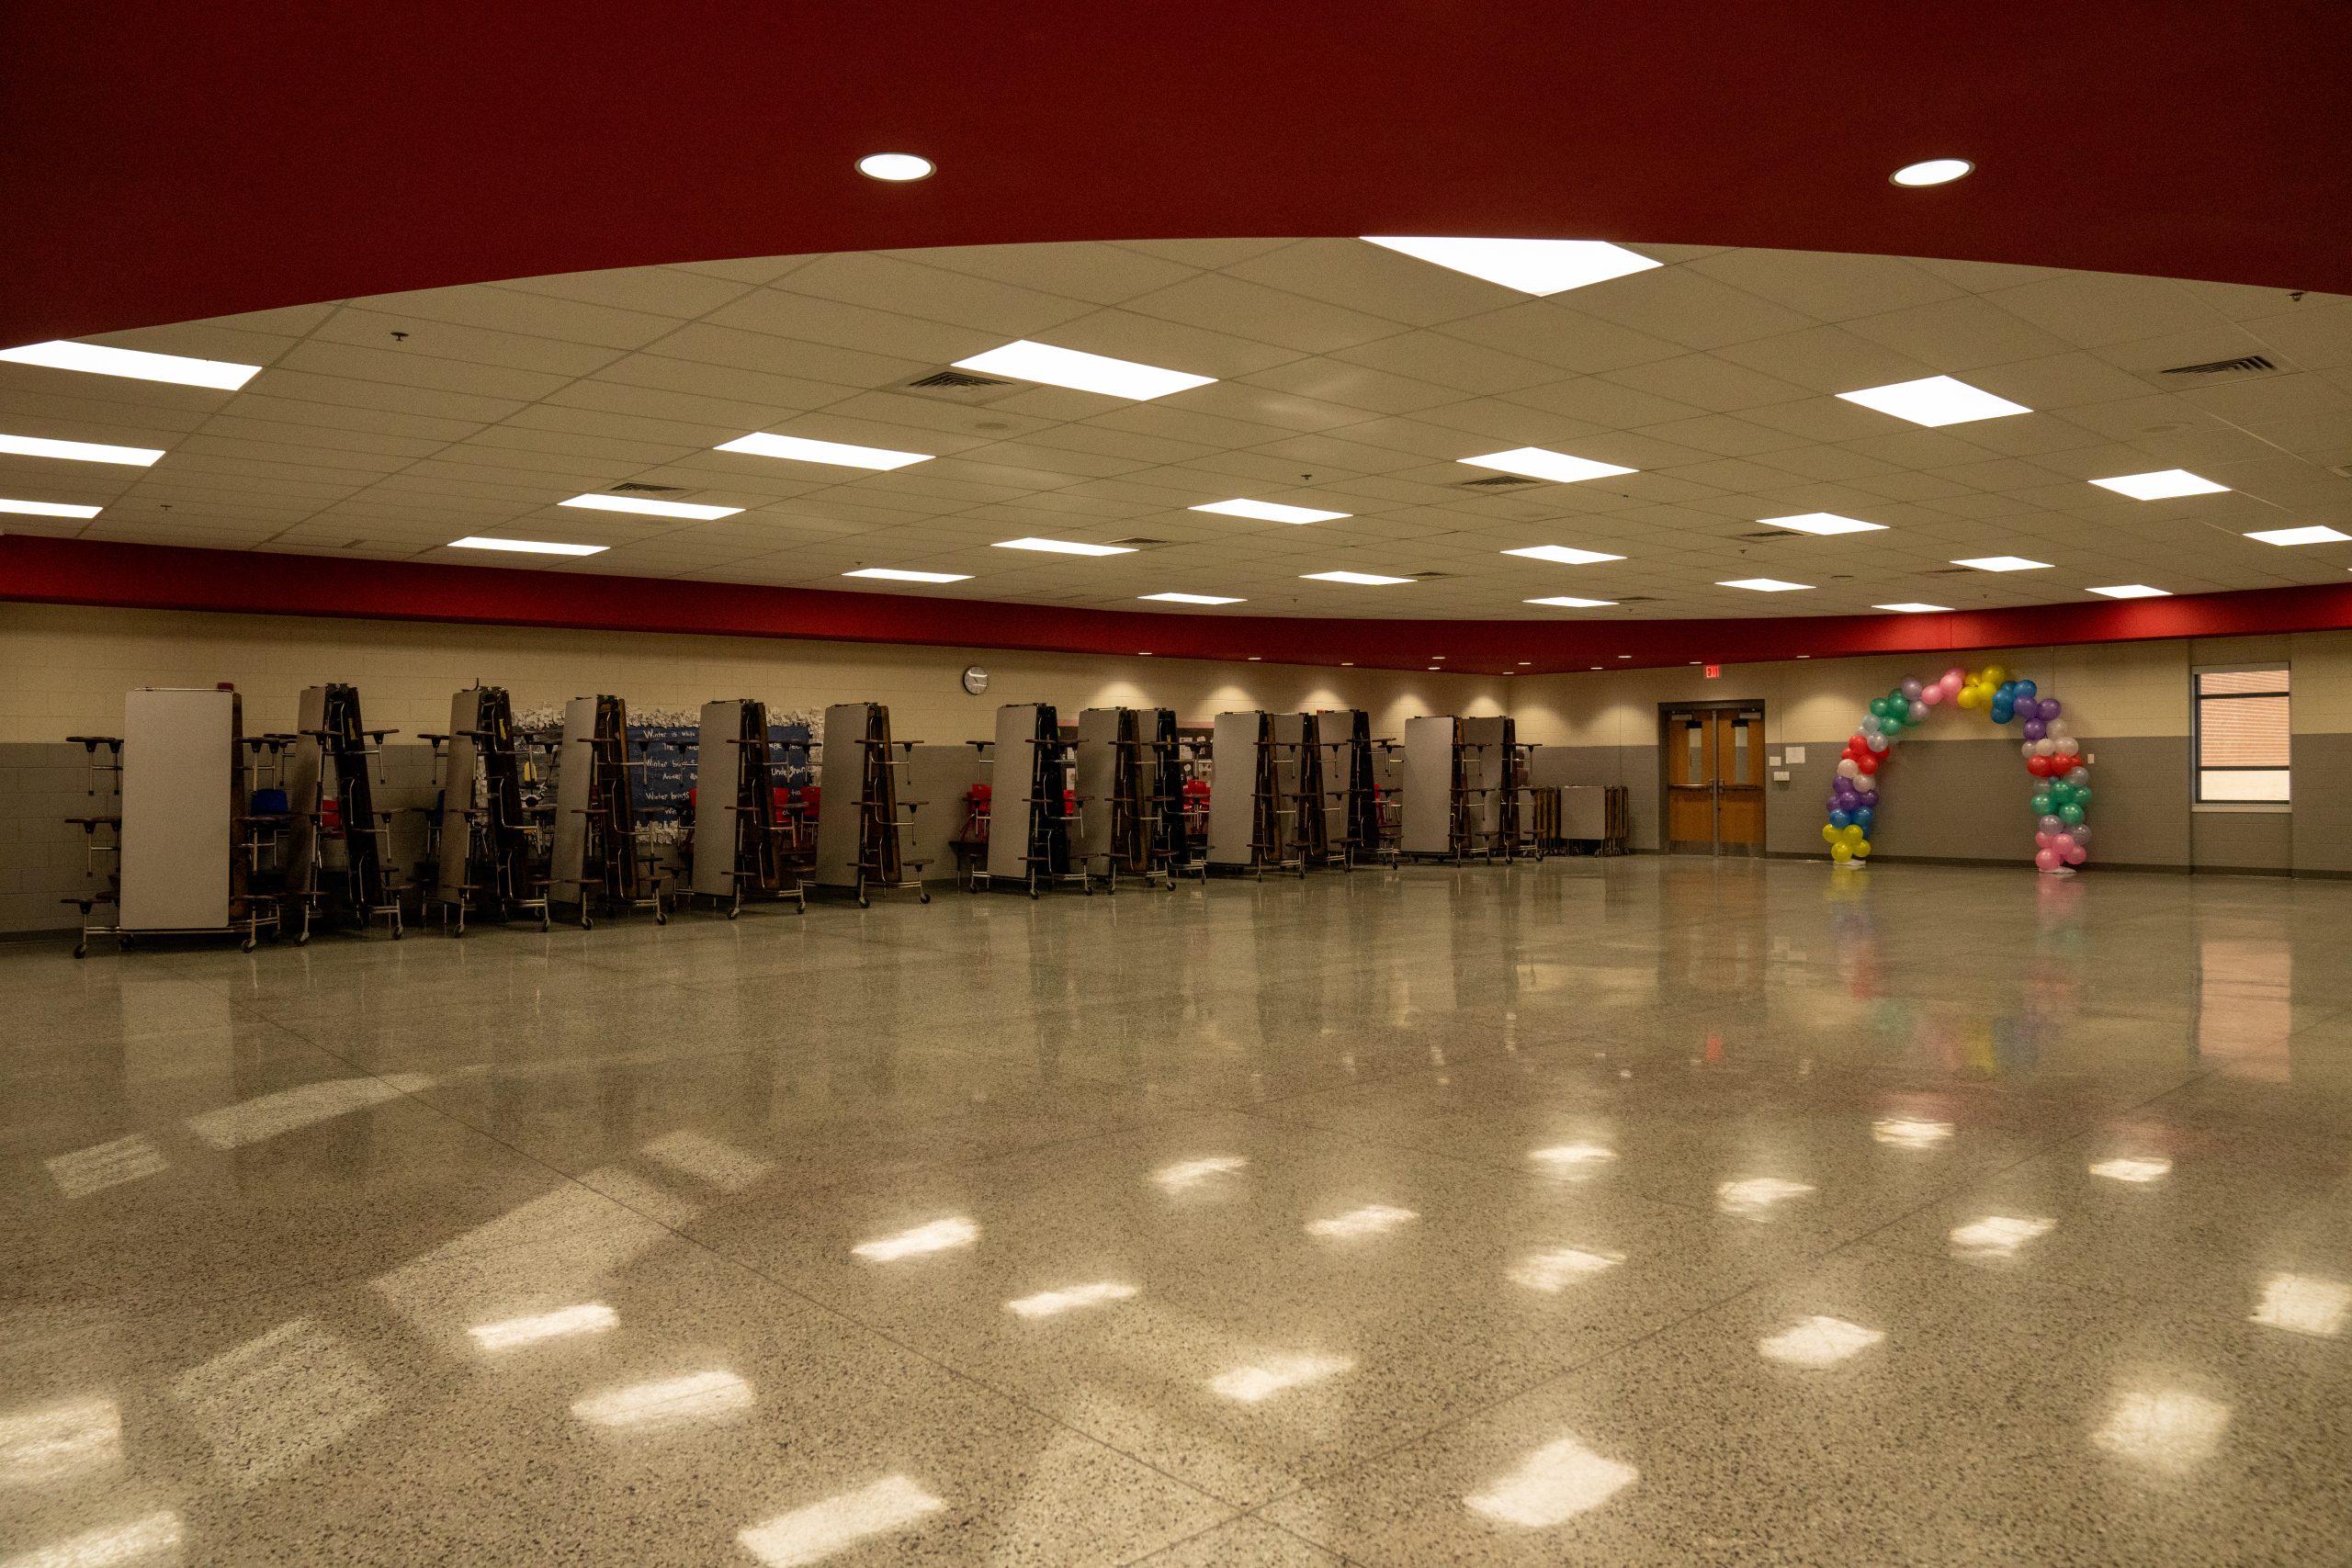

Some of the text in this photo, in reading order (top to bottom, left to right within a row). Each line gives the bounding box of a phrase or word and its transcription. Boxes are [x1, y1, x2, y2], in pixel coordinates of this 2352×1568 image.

[1706, 666, 1720, 678] EXIT
[643, 728, 667, 739] Winter
[646, 757, 668, 768] Winter
[645, 791, 668, 800] Winter
[671, 790, 690, 801] brings
